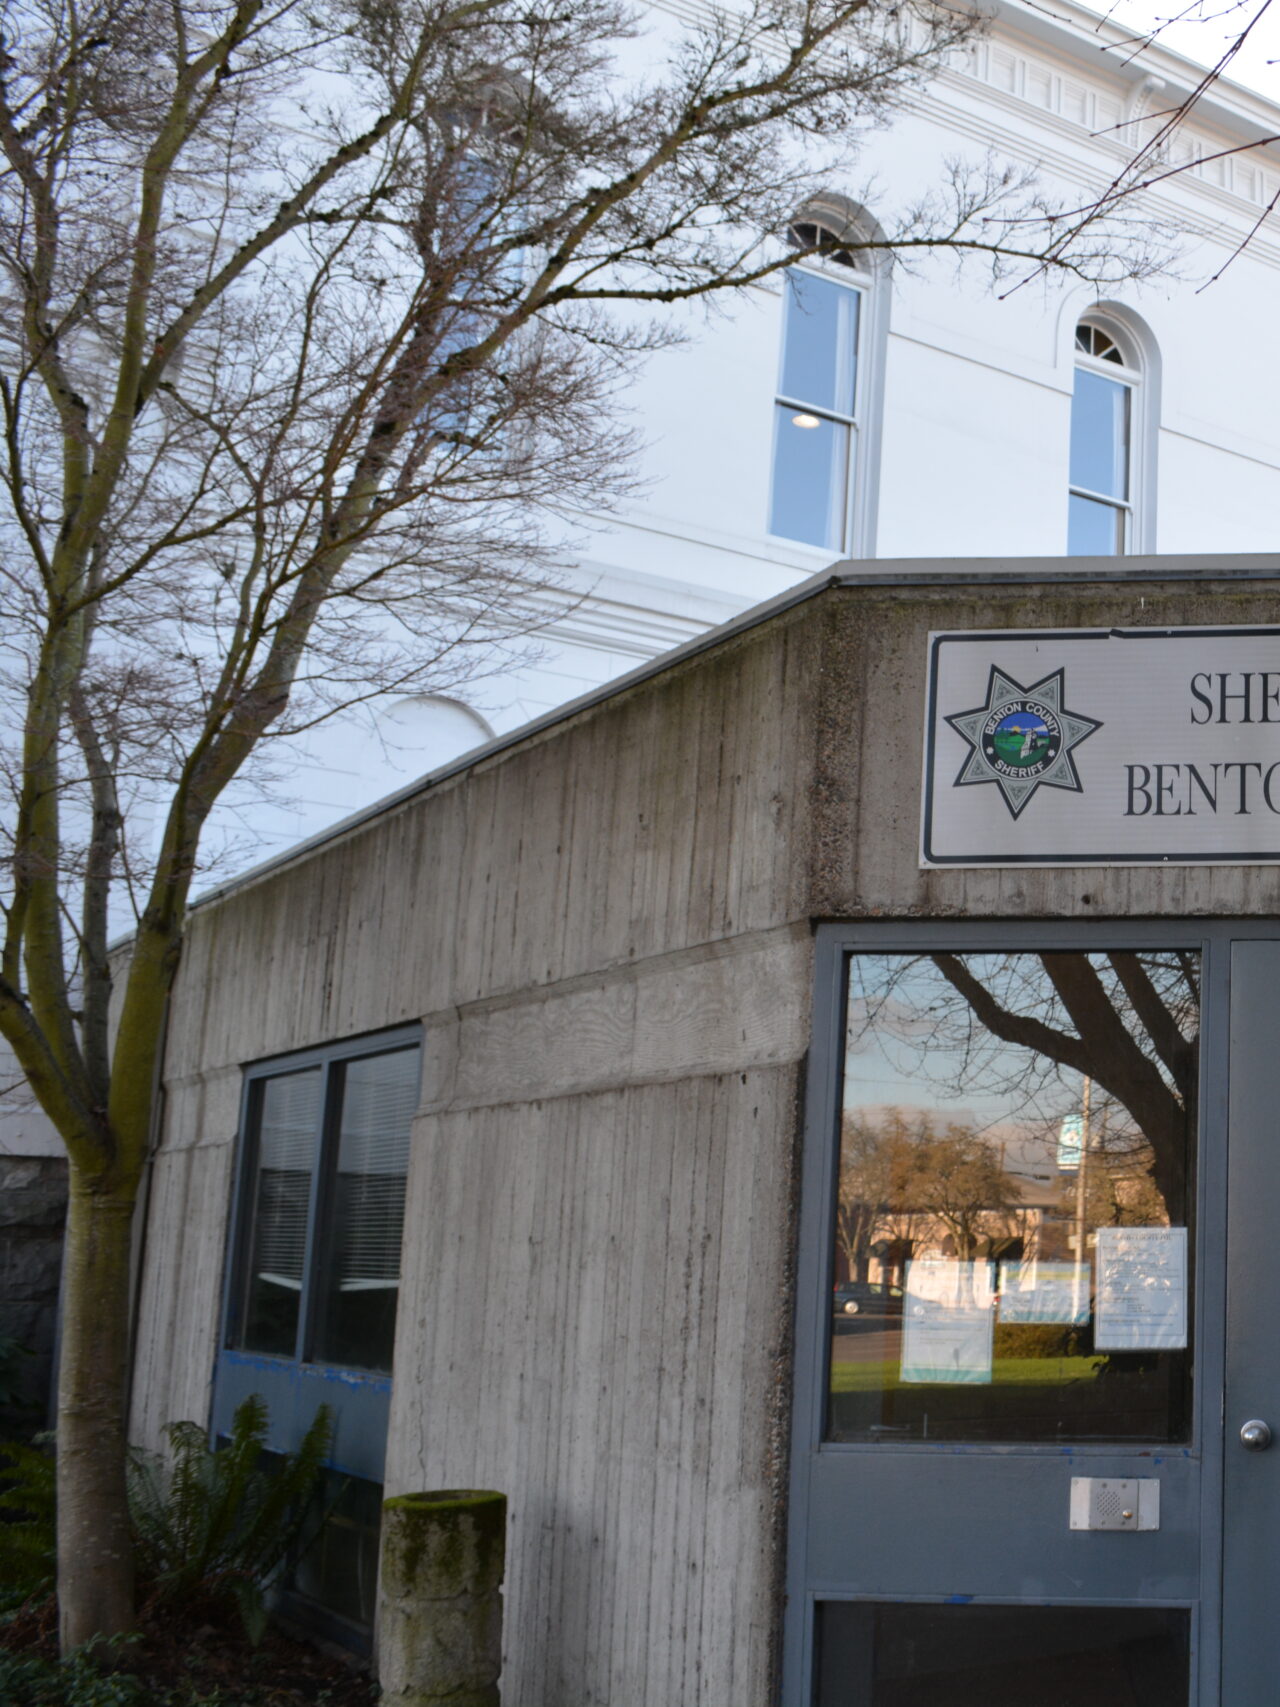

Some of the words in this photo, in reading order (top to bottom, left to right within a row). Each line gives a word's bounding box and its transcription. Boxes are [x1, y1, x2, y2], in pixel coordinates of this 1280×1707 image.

[985, 701, 1021, 735] BENTON
[1026, 702, 1060, 737] COUNTY
[994, 760, 1044, 778] SHERIFF
